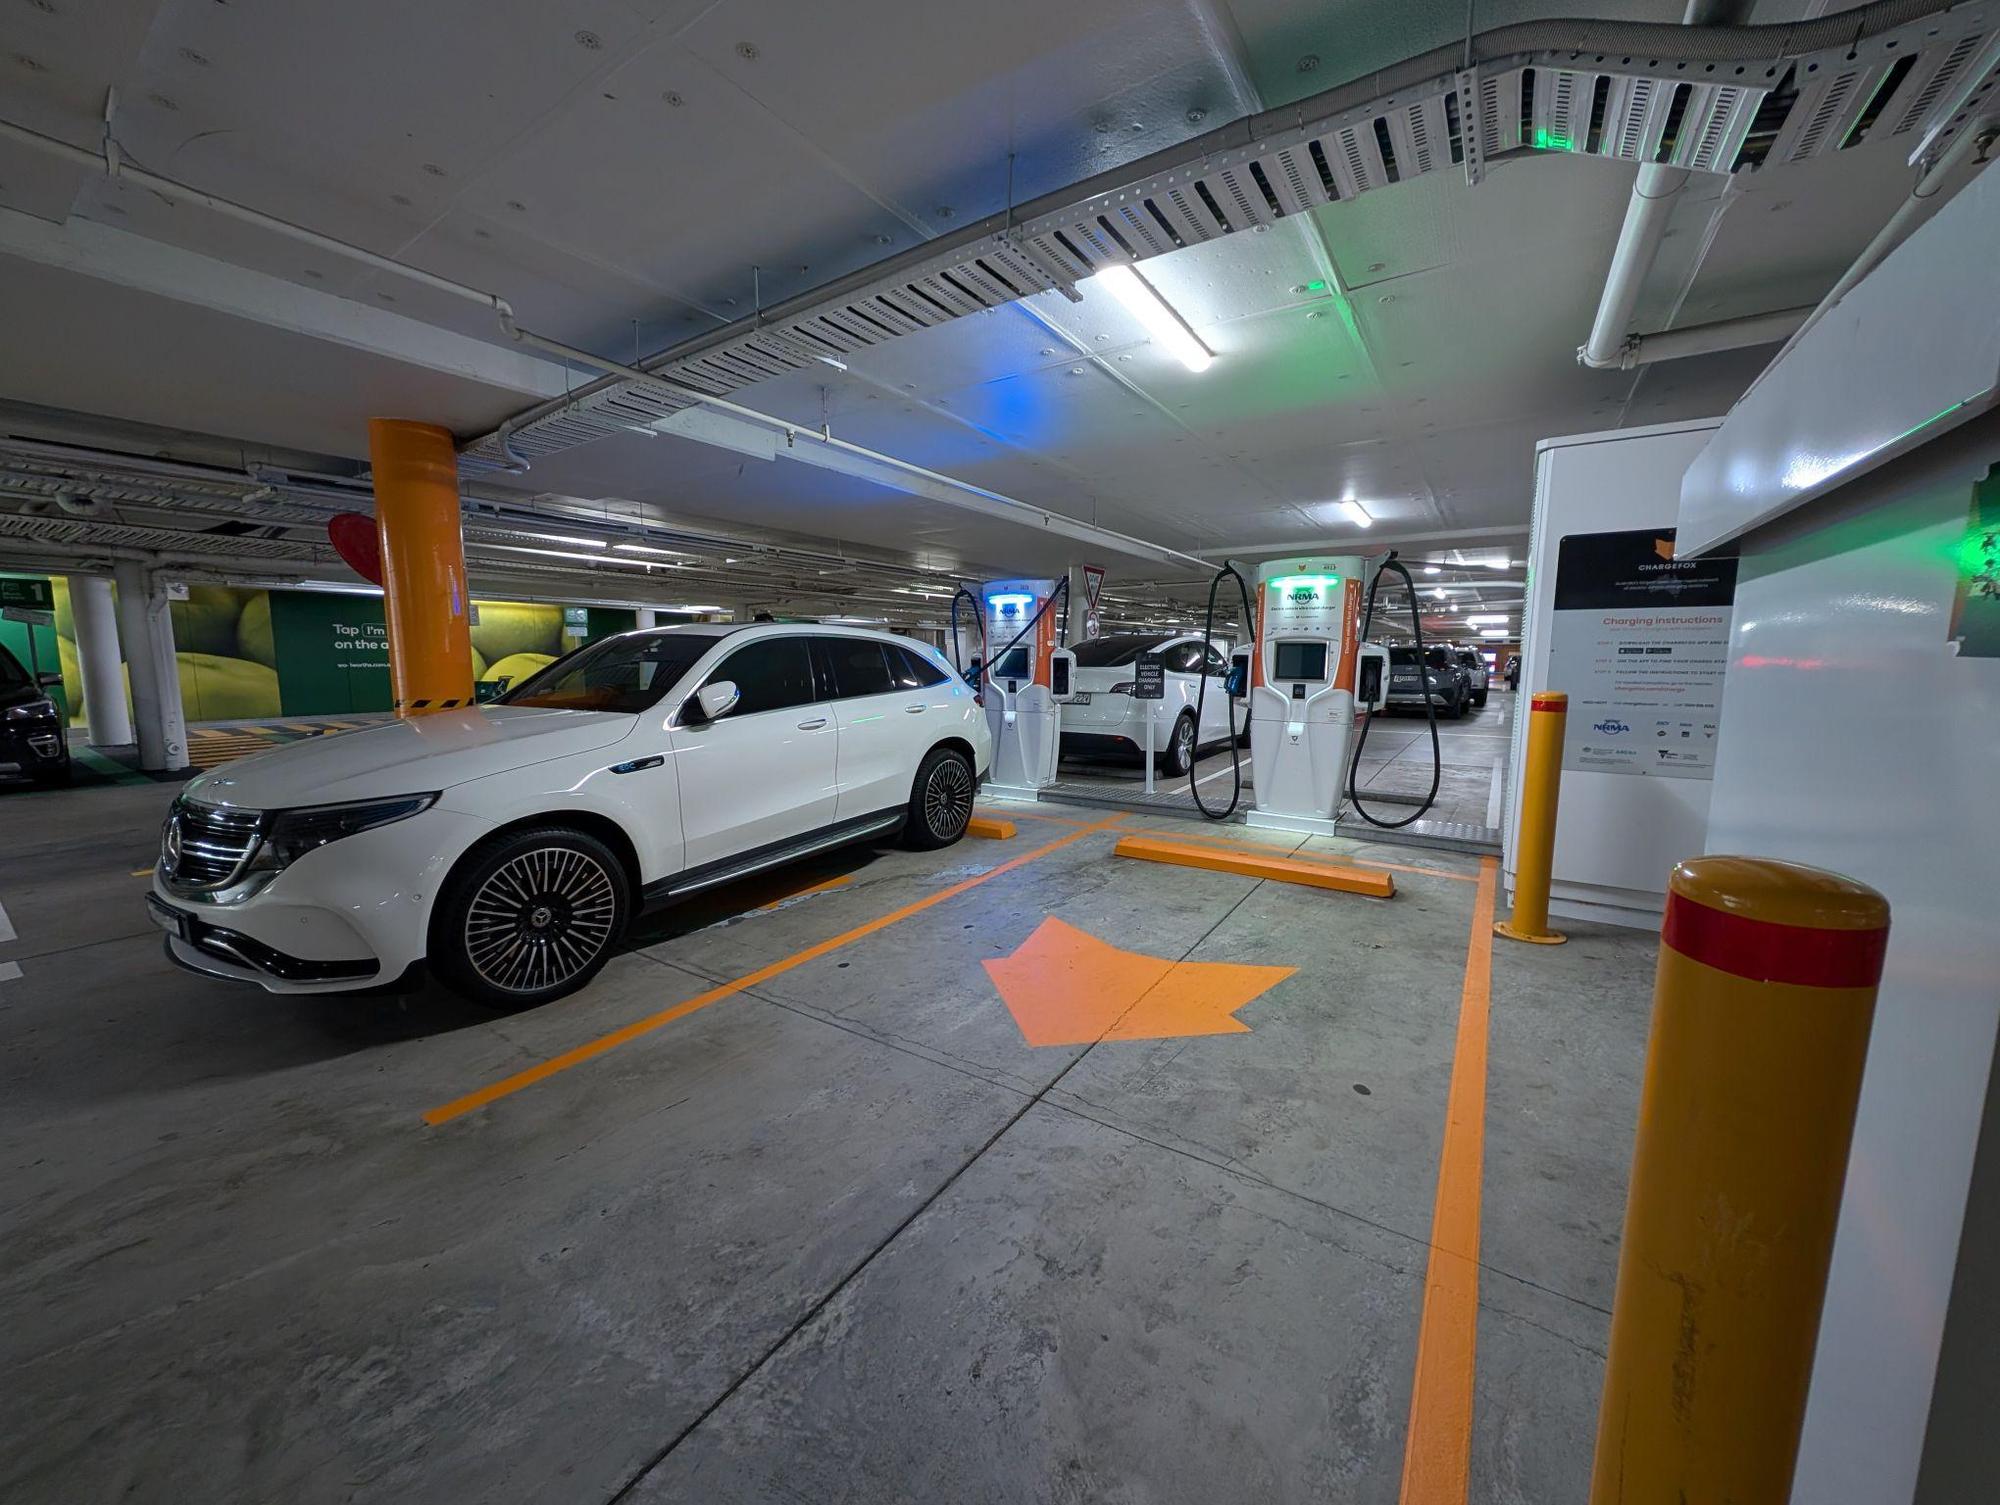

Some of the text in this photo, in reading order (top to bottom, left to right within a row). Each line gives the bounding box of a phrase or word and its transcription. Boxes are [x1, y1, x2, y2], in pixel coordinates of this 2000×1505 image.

[1638, 562, 1697, 571] CHARGEFOX
[31, 583, 44, 601] 1
[1286, 592, 1320, 601] NRMA
[1603, 616, 1654, 626] Charging
[332, 624, 385, 637] Tap I'm
[334, 641, 353, 649] on
[354, 639, 378, 649] the
[1593, 723, 1630, 732] NRMA
